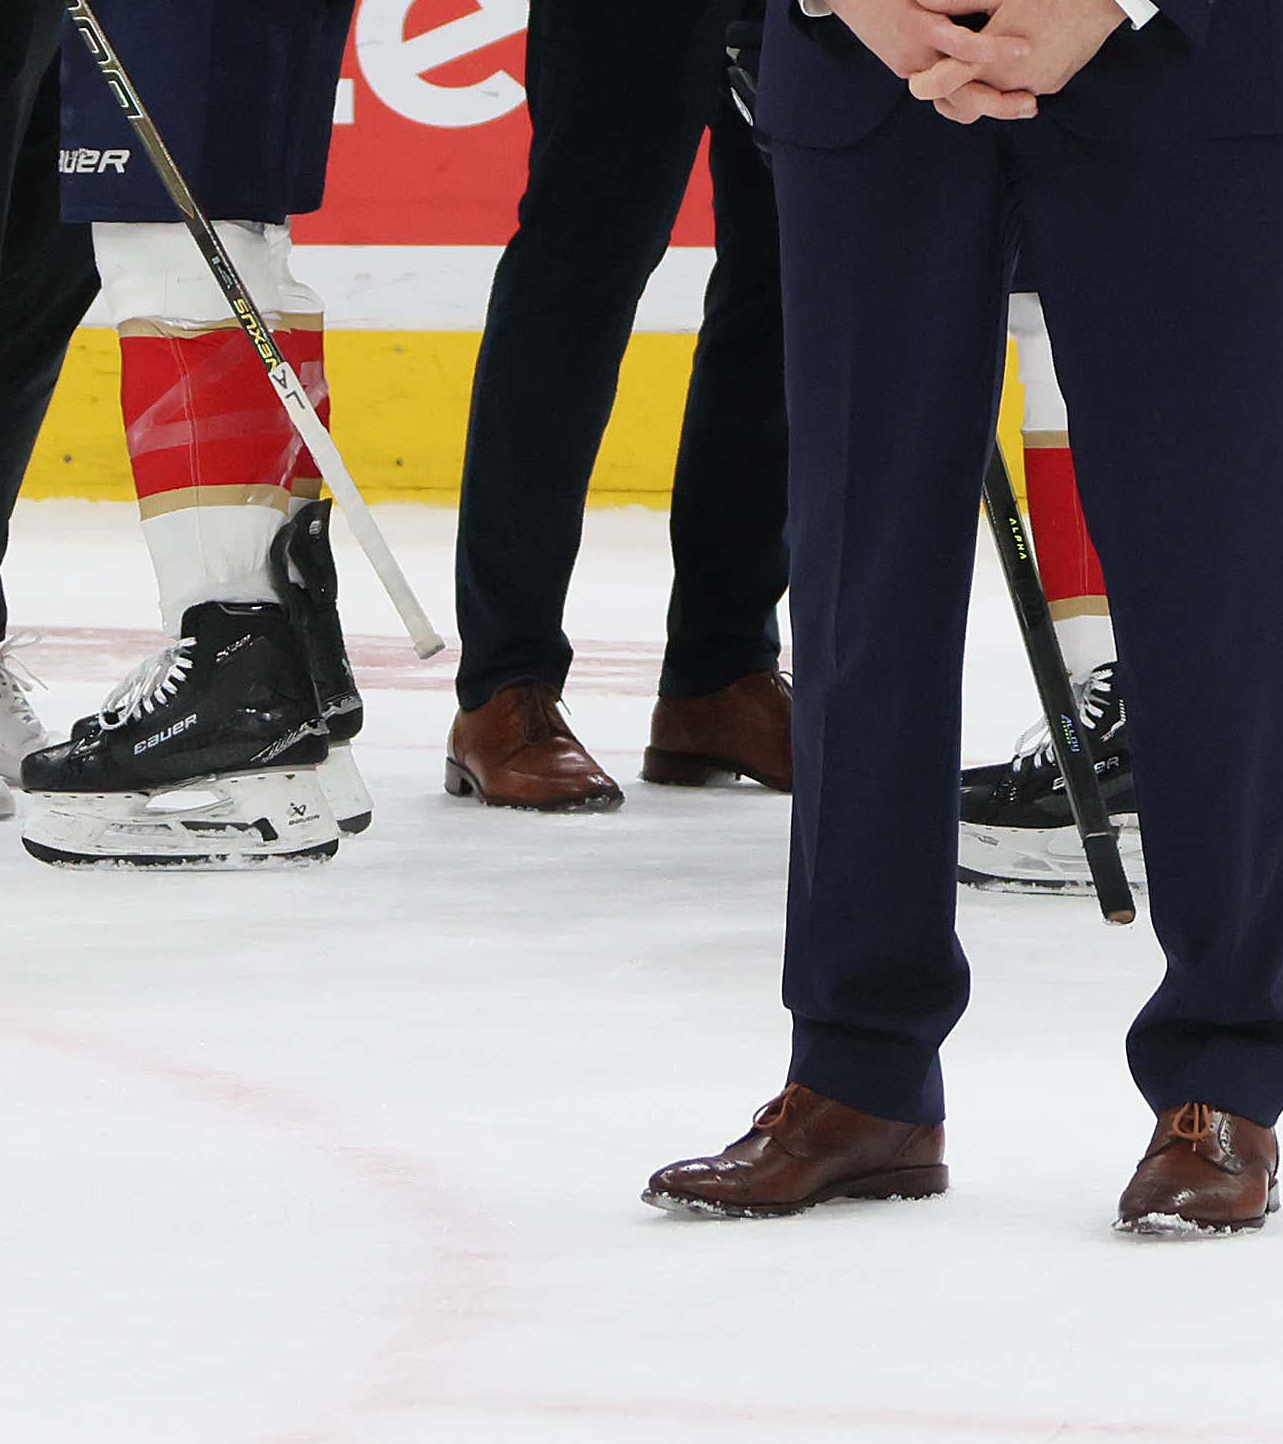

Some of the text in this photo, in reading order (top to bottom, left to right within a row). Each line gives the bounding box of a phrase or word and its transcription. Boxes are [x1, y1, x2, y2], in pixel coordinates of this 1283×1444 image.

[233, 297, 280, 372] NEXUS
[1008, 517, 1028, 561] ALPHA
[133, 713, 198, 756] BAUER
